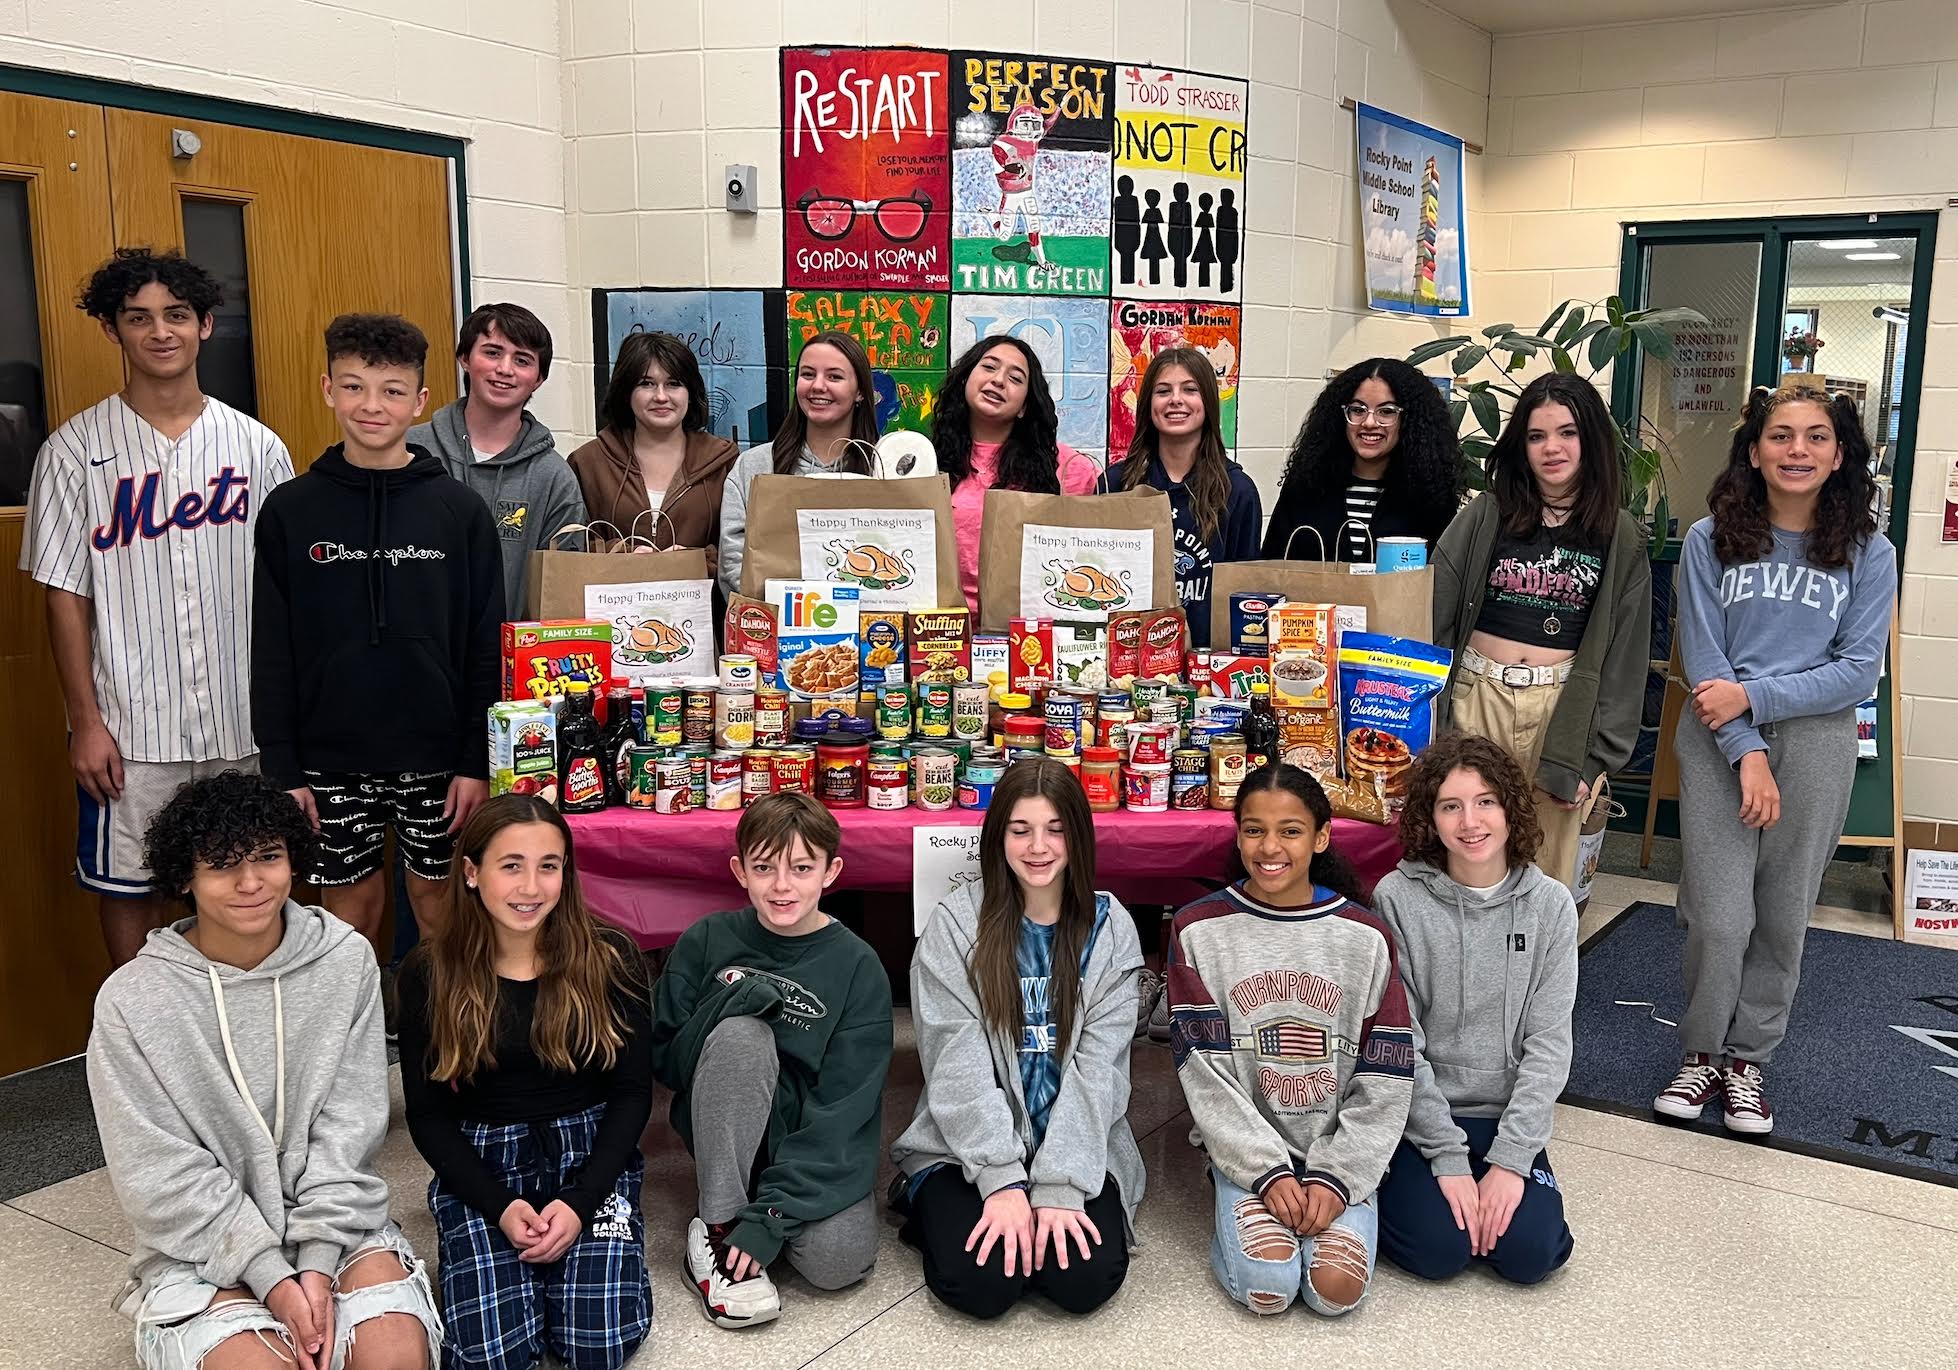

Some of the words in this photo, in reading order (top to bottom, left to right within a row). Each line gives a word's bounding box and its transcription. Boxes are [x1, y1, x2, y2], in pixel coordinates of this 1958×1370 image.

[965, 58, 1108, 93] PERFECT
[967, 84, 1104, 121] SEASON
[1126, 81, 1169, 105] TODD
[1176, 86, 1241, 113] STRASSER
[877, 155, 898, 166] LOSE
[898, 155, 917, 165] YOUR
[917, 154, 948, 164] MEMORY
[1366, 147, 1391, 171] Rocky
[1392, 154, 1412, 175] Point
[886, 168, 904, 177] FIND
[905, 167, 926, 176] YOUR
[1362, 169, 1387, 191] Middle
[1388, 178, 1415, 198] School
[1372, 197, 1400, 222] Library
[796, 248, 869, 273] GORDON
[875, 246, 937, 272] KORMAN
[958, 264, 1018, 289] TIM
[1025, 264, 1104, 292] GREEN
[788, 292, 934, 327] GALAXY
[1188, 306, 1231, 327] KORMAN
[1675, 334, 1687, 345] BY
[1688, 334, 1713, 345] MORE
[1715, 334, 1739, 345] THAN
[1695, 351, 1736, 362] PERSONS
[1673, 367, 1681, 378] IS
[1683, 367, 1736, 378] DANGEROUS
[1694, 383, 1712, 395] AND
[91, 466, 248, 553] Mets
[809, 517, 847, 530] Happy
[849, 517, 923, 530] Thanksgiving
[1033, 533, 1067, 549] Happy
[1071, 536, 1142, 551] Thanksgiving
[1174, 528, 1213, 569] POINT
[598, 593, 633, 605] Happy
[636, 588, 701, 602] Thanksgiving
[1720, 561, 1849, 622] DEWEY
[784, 591, 838, 628] life
[740, 620, 771, 631] IDAHOAN
[913, 614, 966, 635] Stuffing
[1282, 618, 1314, 628] PUMPKIN
[543, 629, 573, 638] FAMILY
[574, 628, 593, 636] SIZE
[1146, 622, 1180, 642] IDAHOAN
[1282, 628, 1301, 637] SPICE
[520, 634, 537, 645] Post
[923, 642, 957, 650] CORNBREAD
[973, 647, 1007, 657] JIFFY
[1057, 642, 1097, 653] CAULIFLOWER
[530, 652, 594, 678] FRUITY
[1367, 655, 1394, 664] FAMILY
[1355, 679, 1415, 702] KRUSTEAZ
[957, 705, 984, 715] BEANS
[1349, 697, 1410, 721] Buttermilk
[727, 712, 754, 723] CORN
[1288, 714, 1325, 726] Organic
[534, 747, 552, 755] JUICE
[773, 761, 807, 770] Hormel
[1174, 757, 1205, 767] STAGG
[568, 768, 596, 784] Butter-
[777, 769, 801, 779] Chili
[827, 770, 851, 779] Folgers
[870, 770, 900, 781] Campbell's
[925, 773, 952, 784] BEANS
[664, 778, 691, 786] SOUP
[929, 835, 967, 848] Rocky
[1915, 859, 1927, 870] Help
[1927, 859, 1940, 870] Save
[1940, 860, 1949, 870] The
[307, 866, 374, 885] Champion
[1229, 970, 1344, 1017] TURNPOINT
[1258, 1066, 1337, 1107] SPORTS
